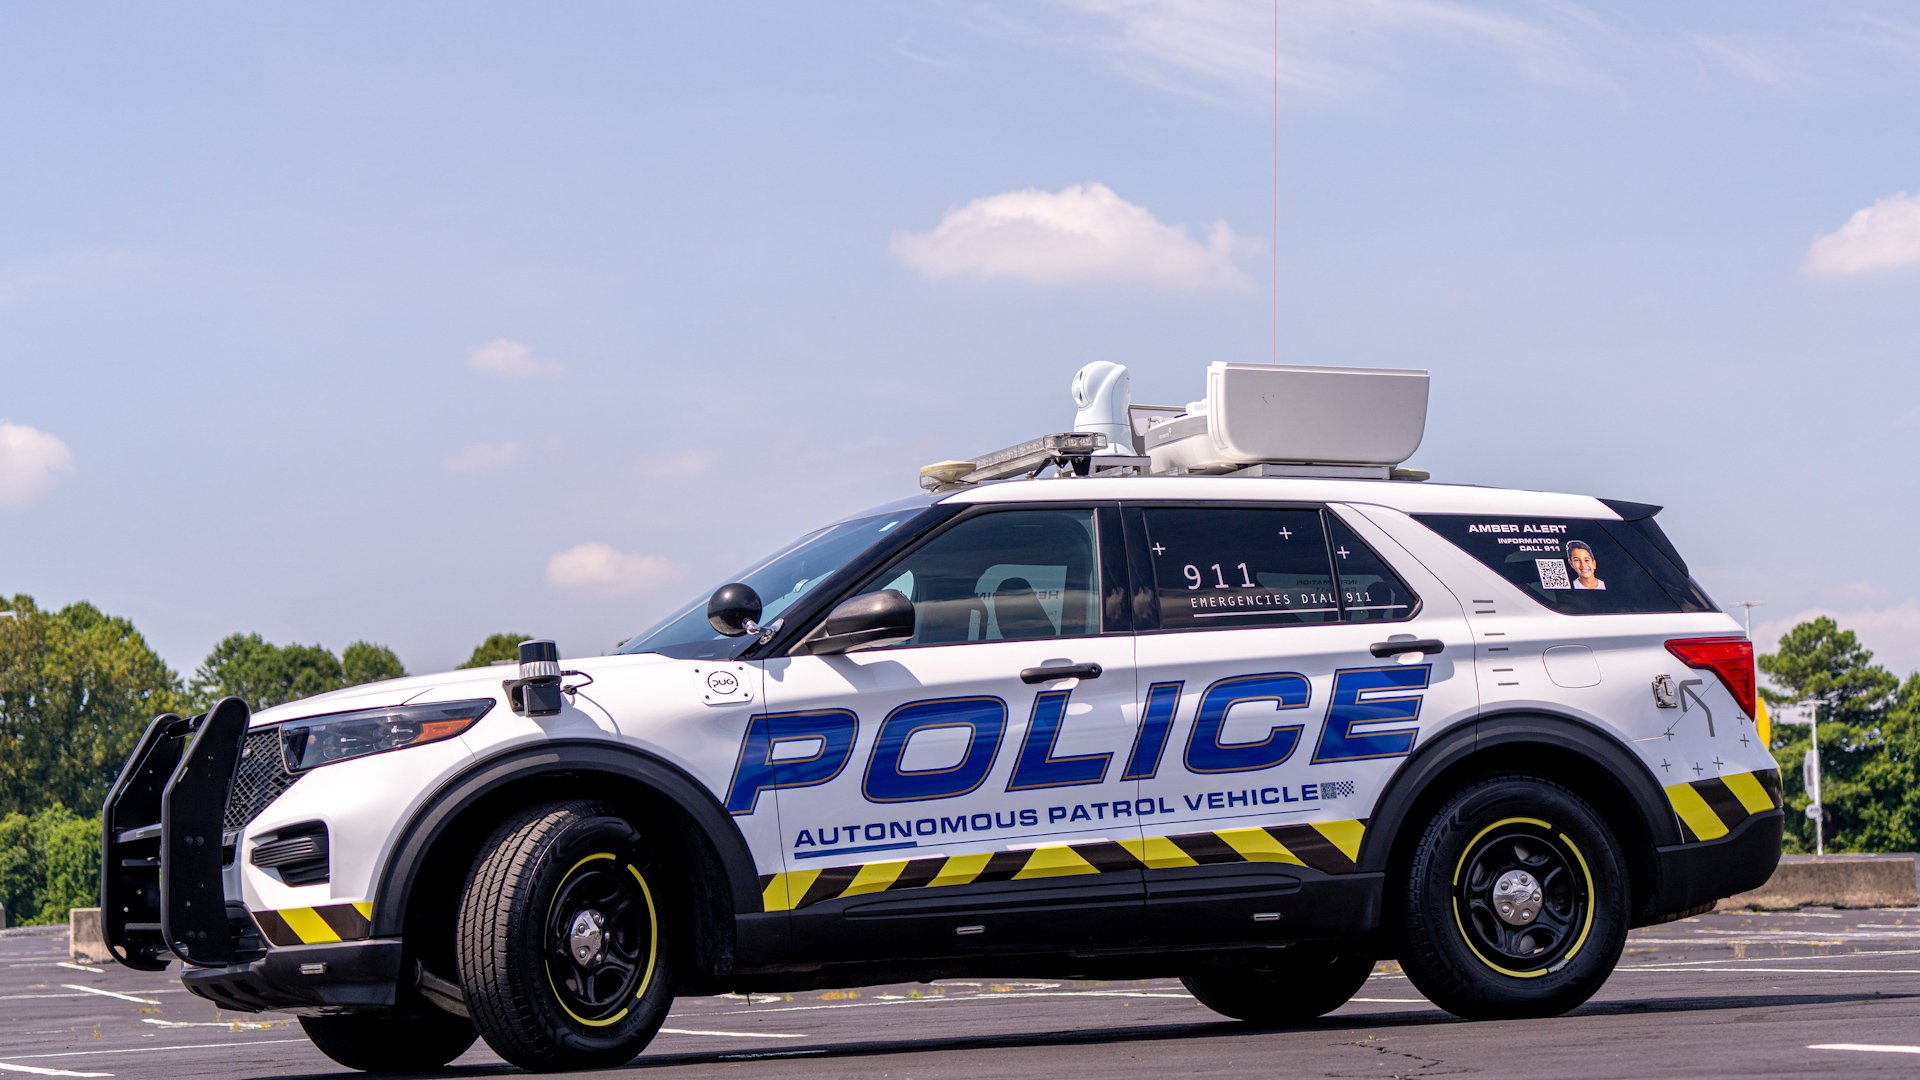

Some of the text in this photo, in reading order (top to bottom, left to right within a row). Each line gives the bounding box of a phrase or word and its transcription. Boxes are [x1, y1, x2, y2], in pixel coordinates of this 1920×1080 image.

[1469, 524, 1567, 533] AMBER ALERT
[1183, 562, 1256, 590] 911
[1190, 592, 1372, 608] EMERGENCIES DIAL 911
[724, 663, 1432, 816] POLICE
[794, 783, 1319, 848] AUTONOMOUS PATROL VEHICLE
